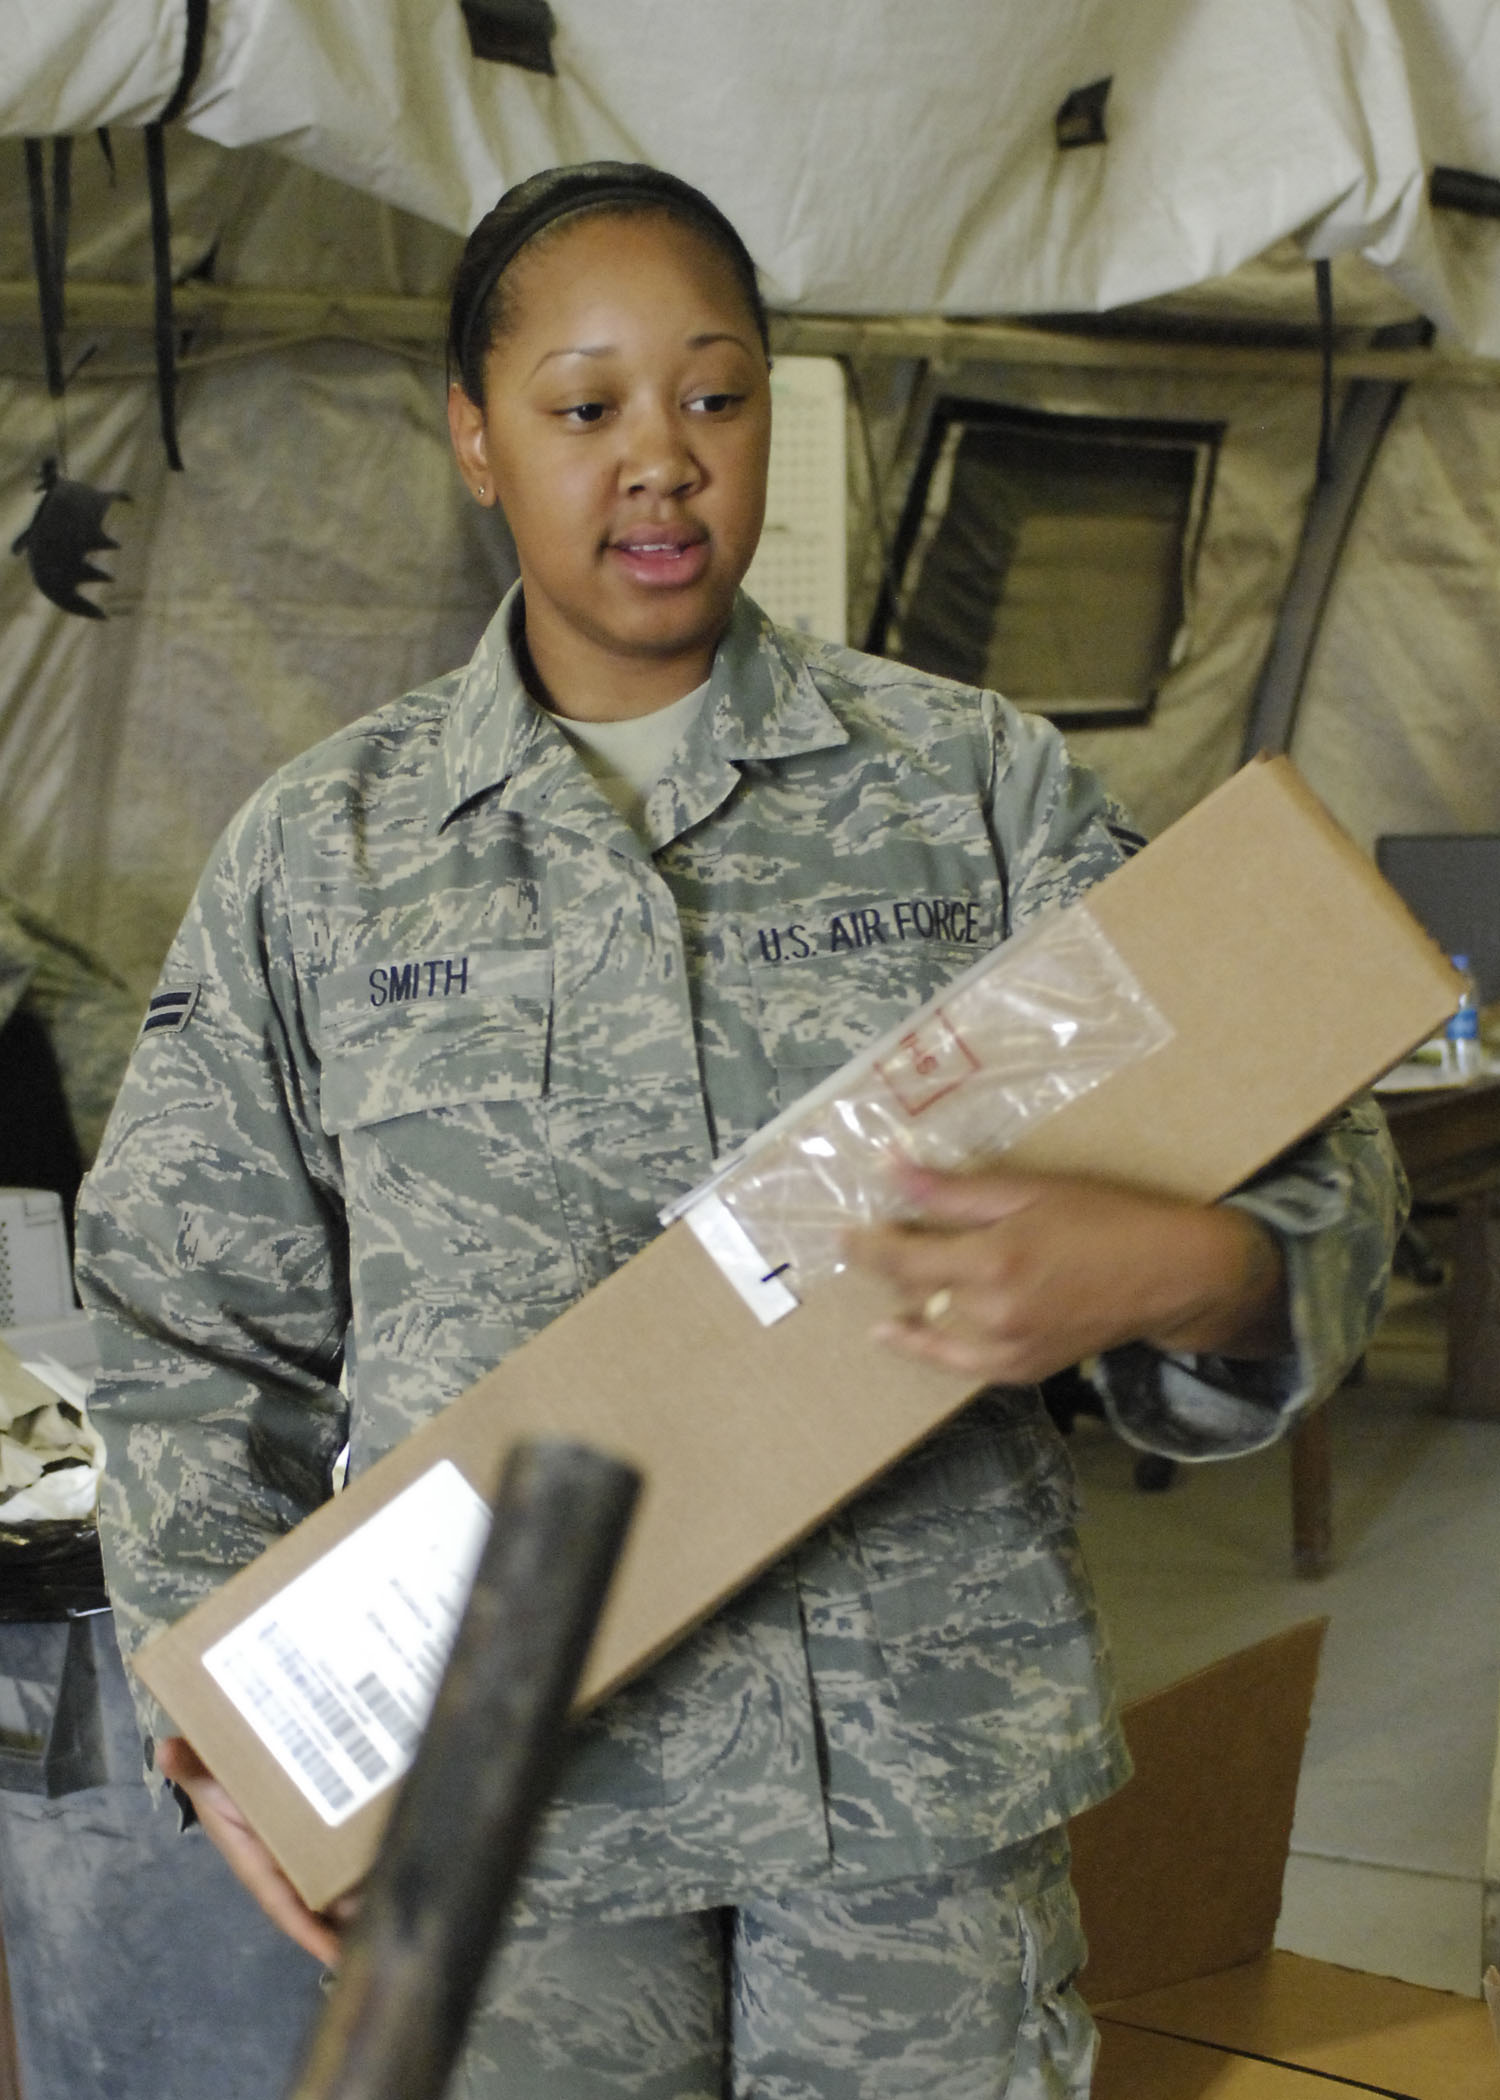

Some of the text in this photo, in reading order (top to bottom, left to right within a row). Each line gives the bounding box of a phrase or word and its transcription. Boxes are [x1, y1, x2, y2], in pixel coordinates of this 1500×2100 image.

[758, 900, 981, 962] U.S. AIR FORCE
[368, 957, 468, 1007] SMITH
